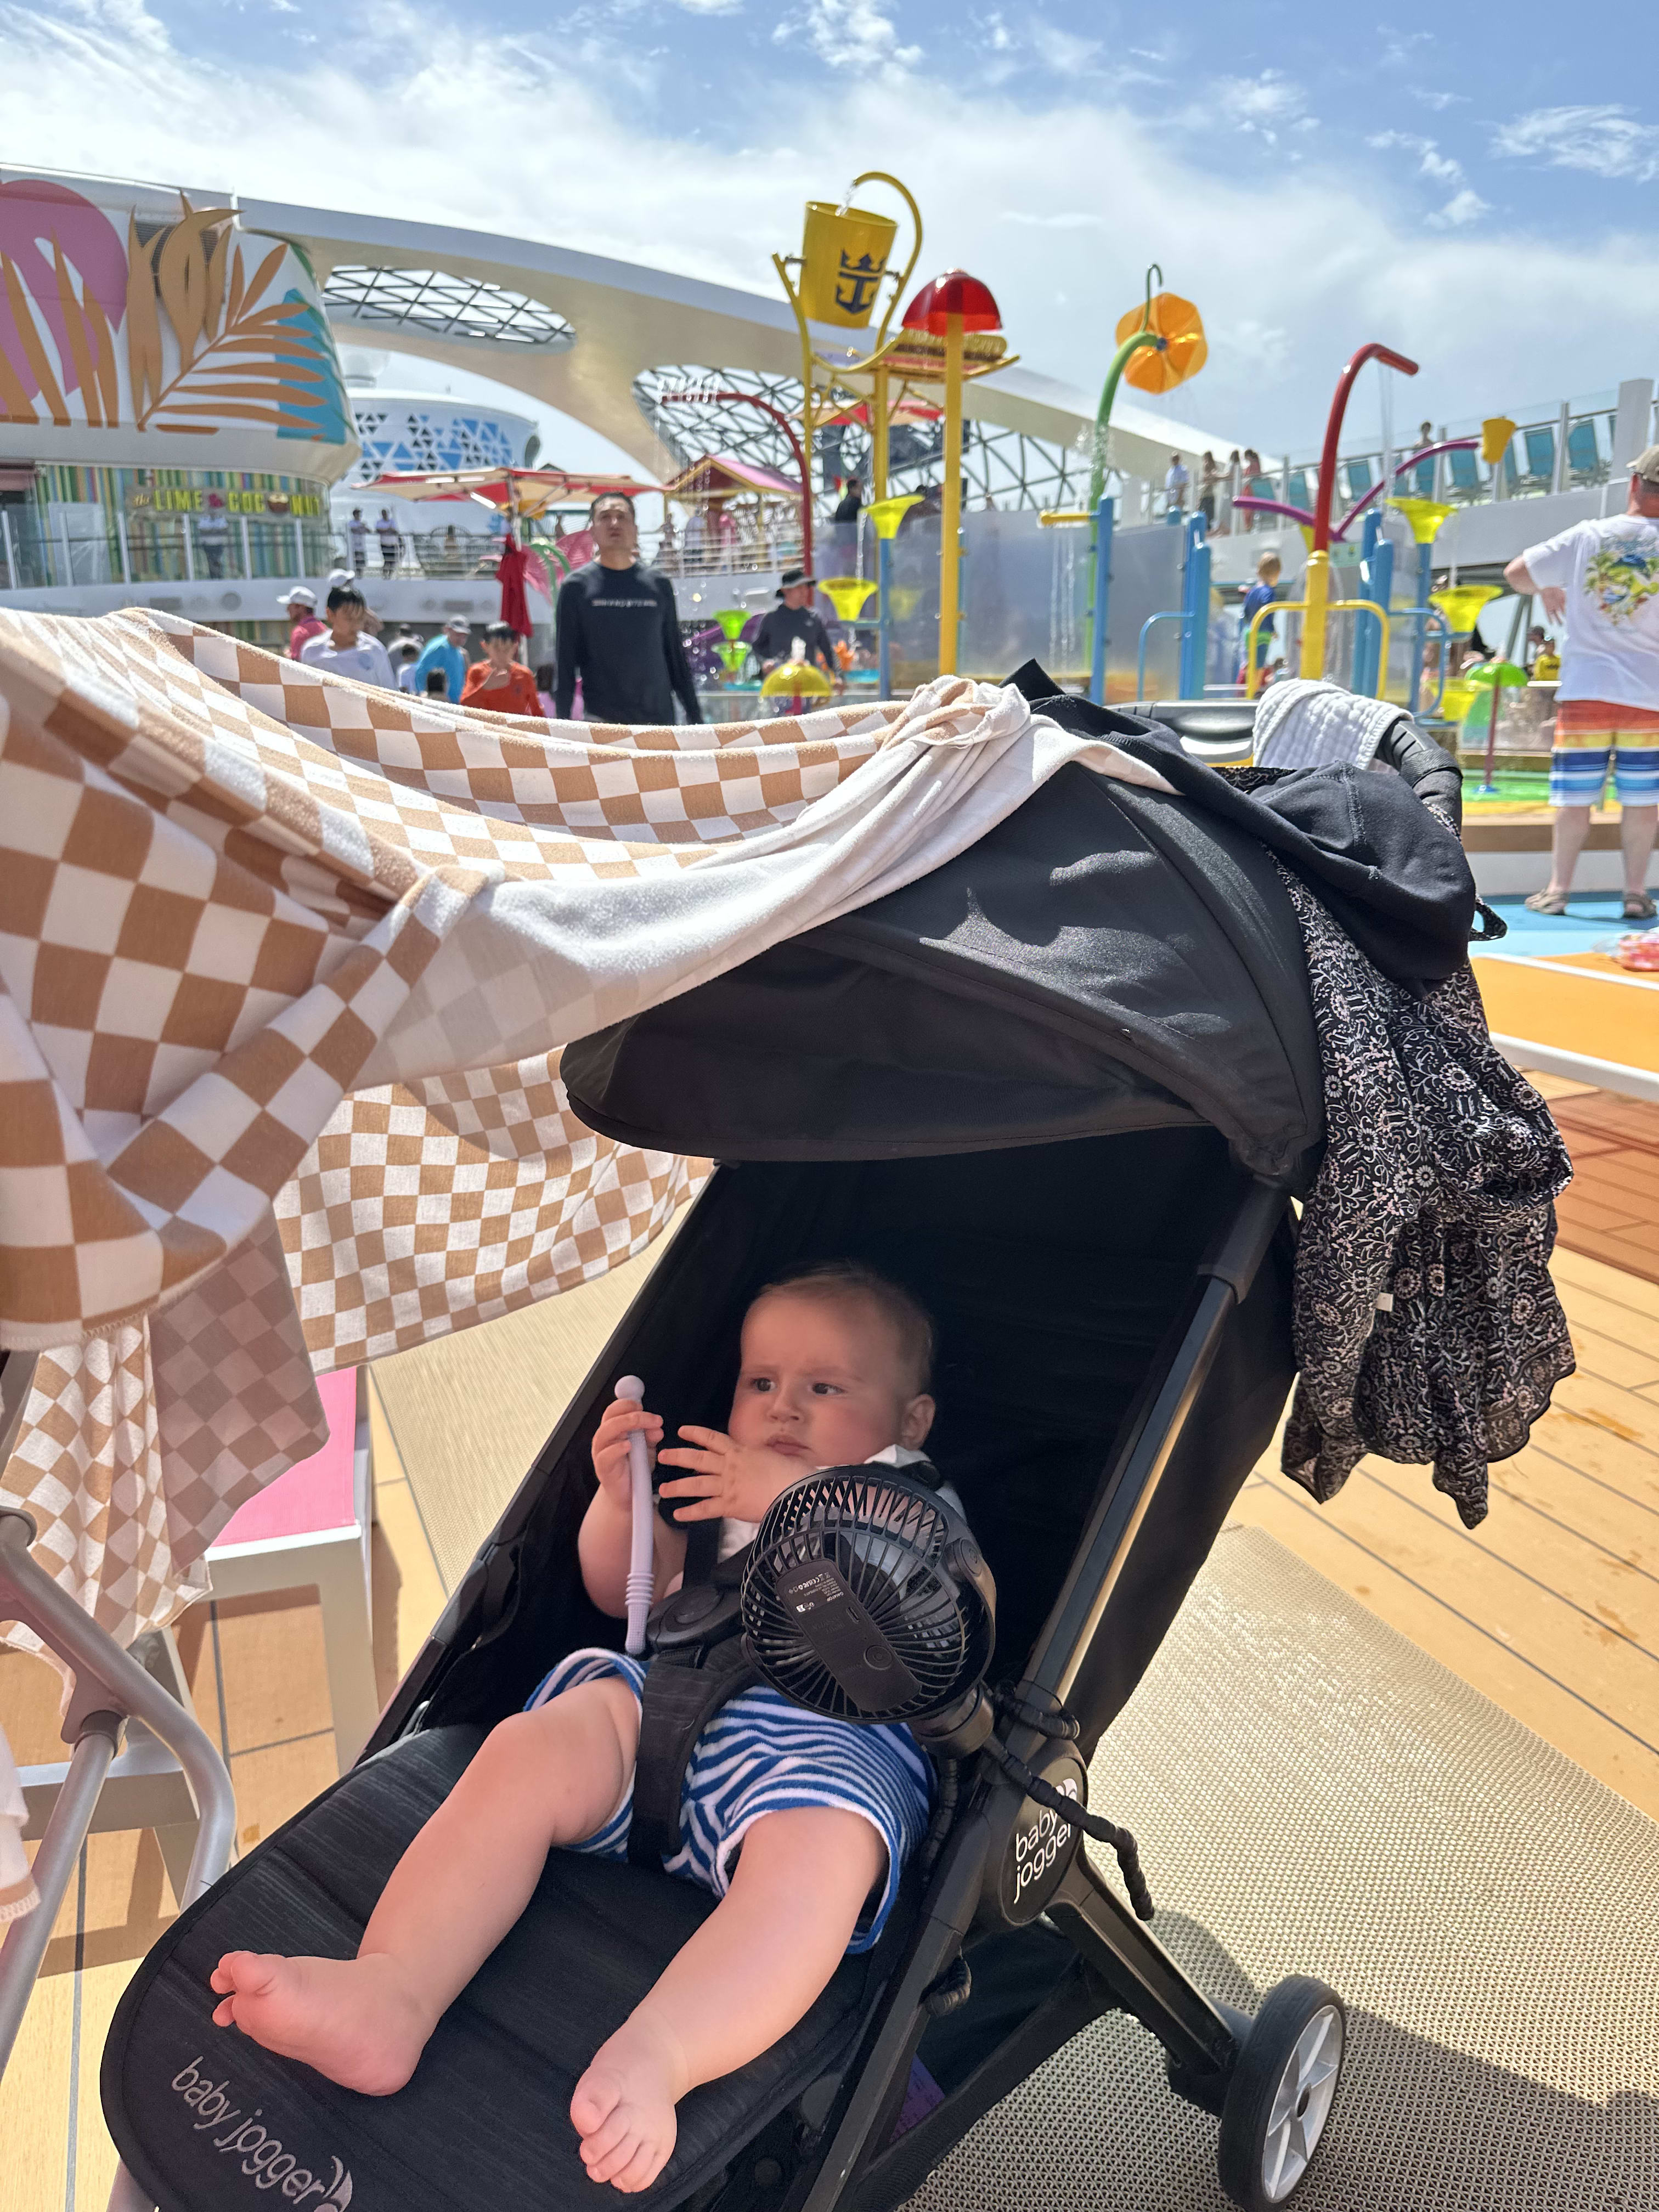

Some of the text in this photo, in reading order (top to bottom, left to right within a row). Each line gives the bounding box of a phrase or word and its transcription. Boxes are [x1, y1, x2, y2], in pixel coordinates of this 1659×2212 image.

[154, 489, 202, 511] LIME
[1015, 1809, 1058, 1862] baby
[172, 2056, 325, 2204] baby jogger
